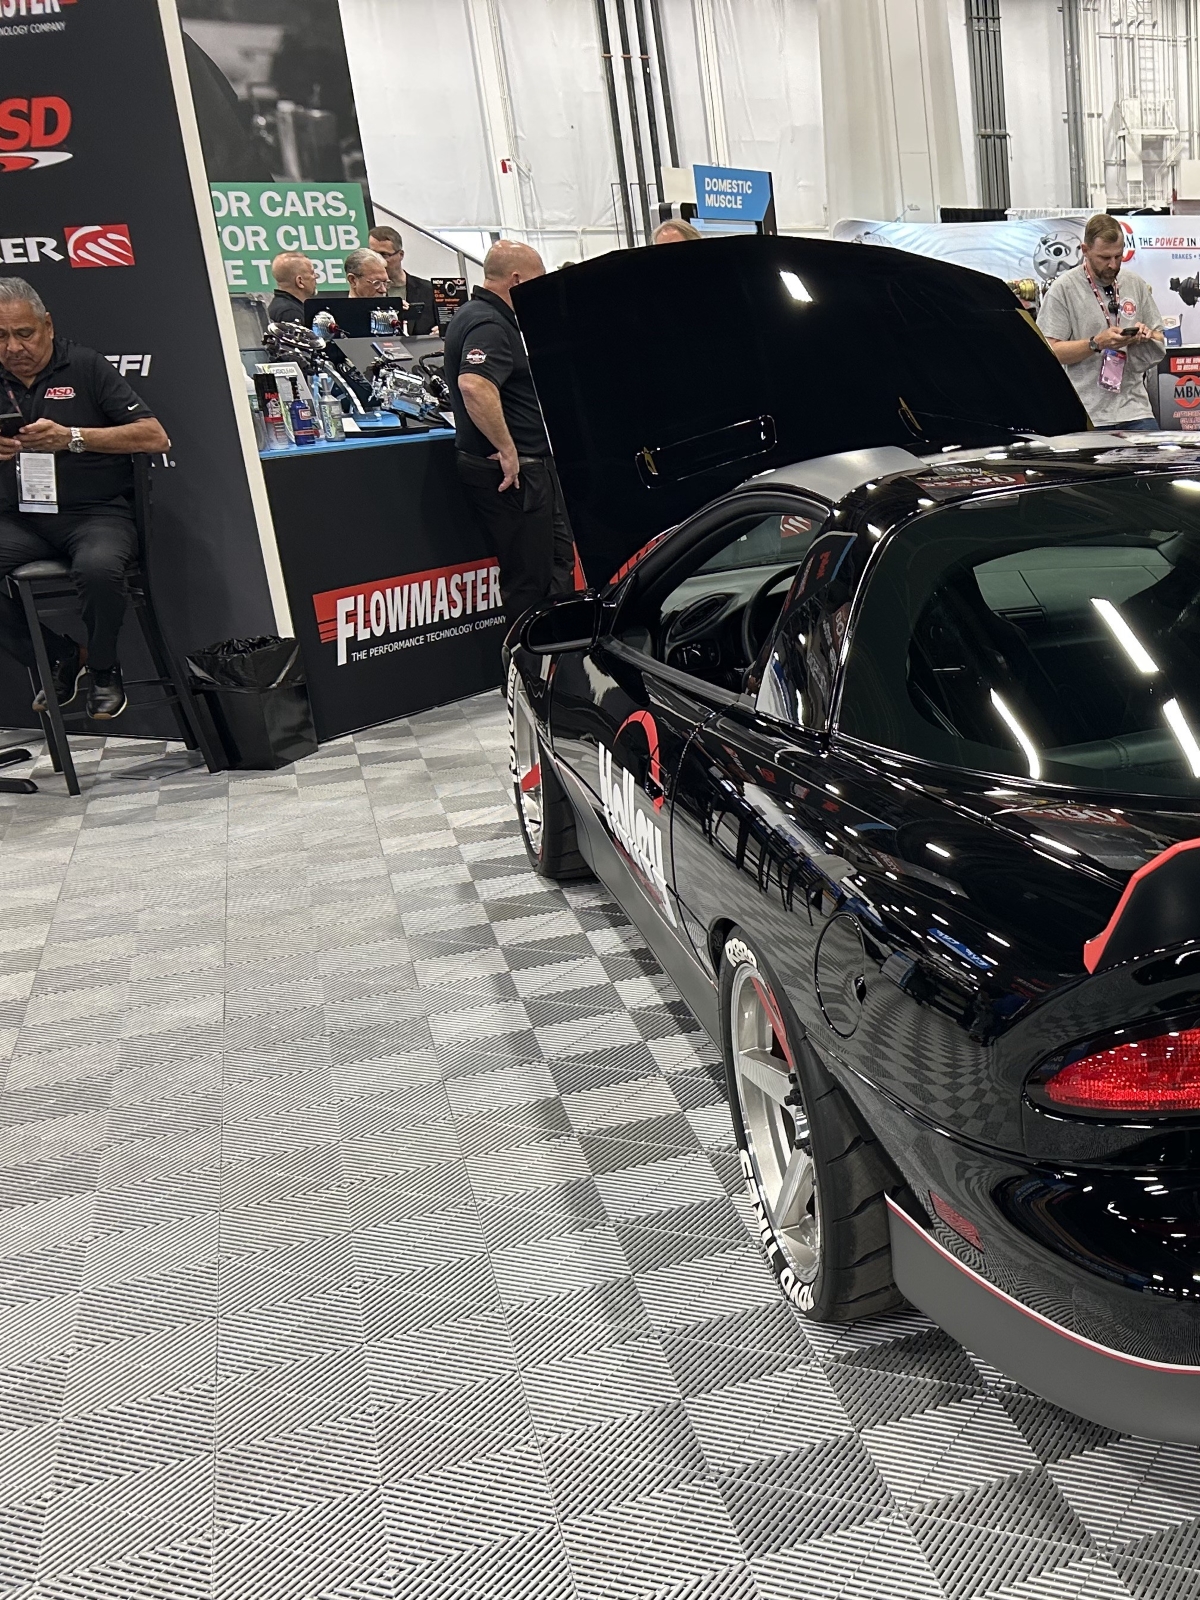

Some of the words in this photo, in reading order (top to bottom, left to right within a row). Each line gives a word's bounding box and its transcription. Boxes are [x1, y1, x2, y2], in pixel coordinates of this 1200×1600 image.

[29, 20, 66, 34] COMPANY
[704, 177, 753, 194] DOMESTIC
[259, 190, 356, 222] CARS,
[705, 193, 743, 209] MUSCLE
[276, 224, 361, 251] CLUB
[1138, 236, 1153, 247] THE
[1154, 237, 1186, 247] POWER
[1186, 237, 1197, 247] IN
[46, 386, 73, 397] MSD
[337, 566, 503, 667] FLOWMASTER
[351, 650, 367, 662] THE
[369, 635, 425, 657] PERFORMANCE
[426, 622, 474, 643] TECHNOLOGY
[474, 615, 507, 631] COMPANY
